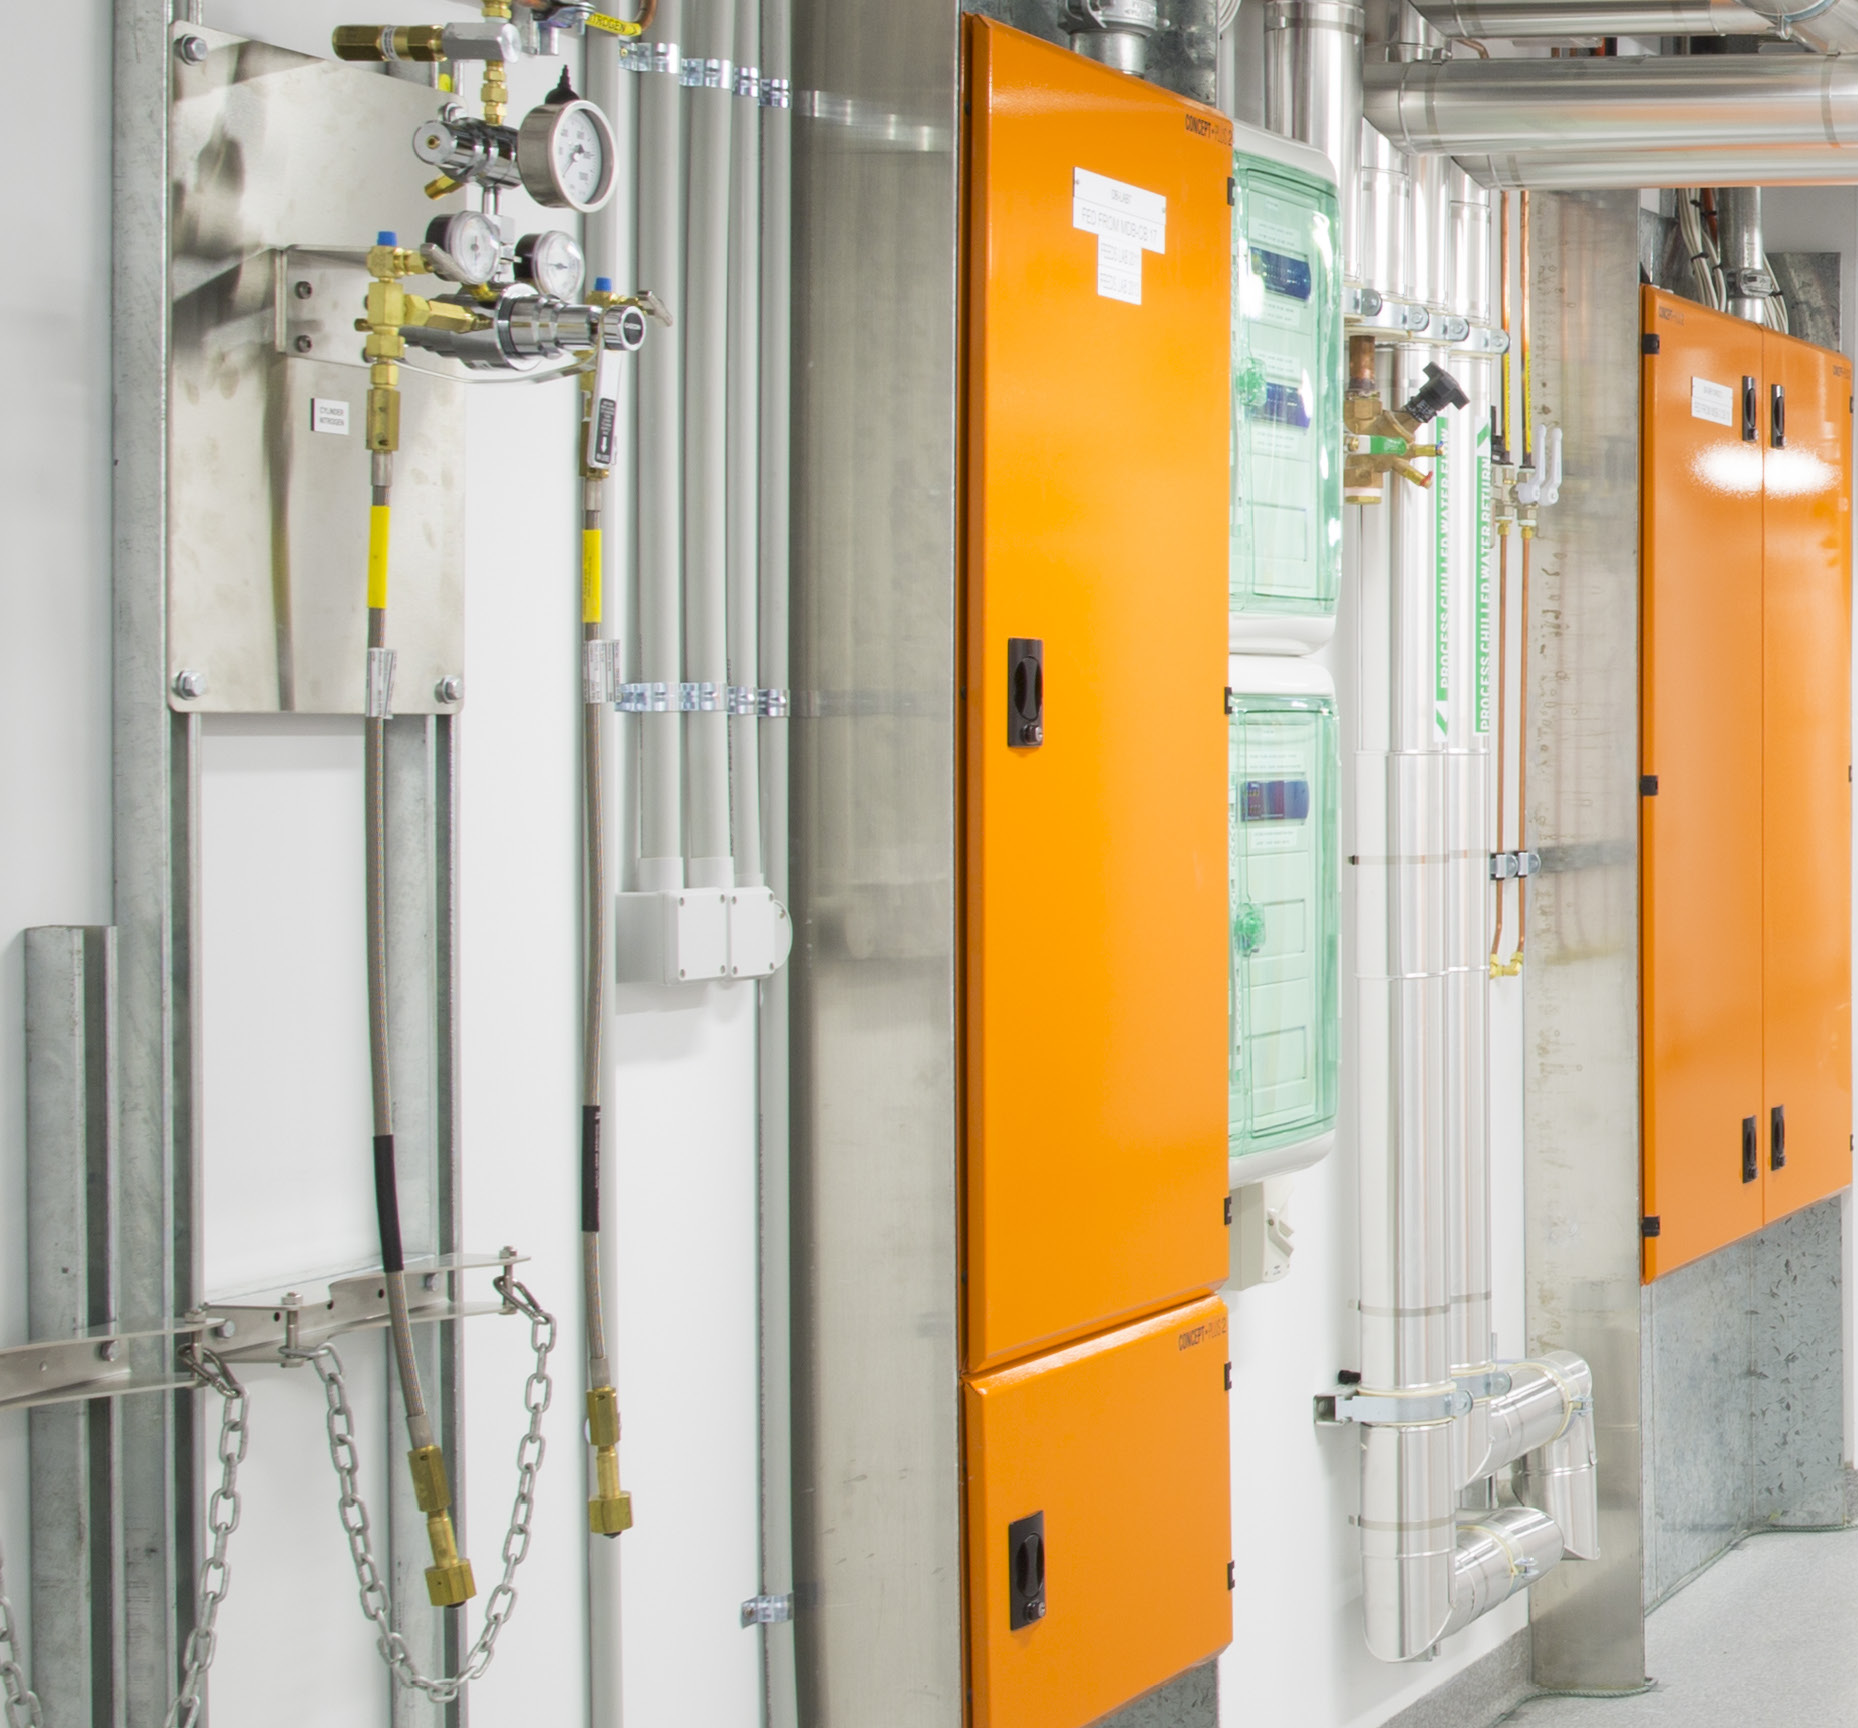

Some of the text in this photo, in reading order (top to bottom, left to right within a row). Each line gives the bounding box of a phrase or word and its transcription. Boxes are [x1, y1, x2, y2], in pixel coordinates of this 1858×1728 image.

[1440, 427, 1450, 689] PROCESS CHILLED WATER FLW
[1480, 457, 1491, 731] PROCESS CHILLED WATER RETURN
